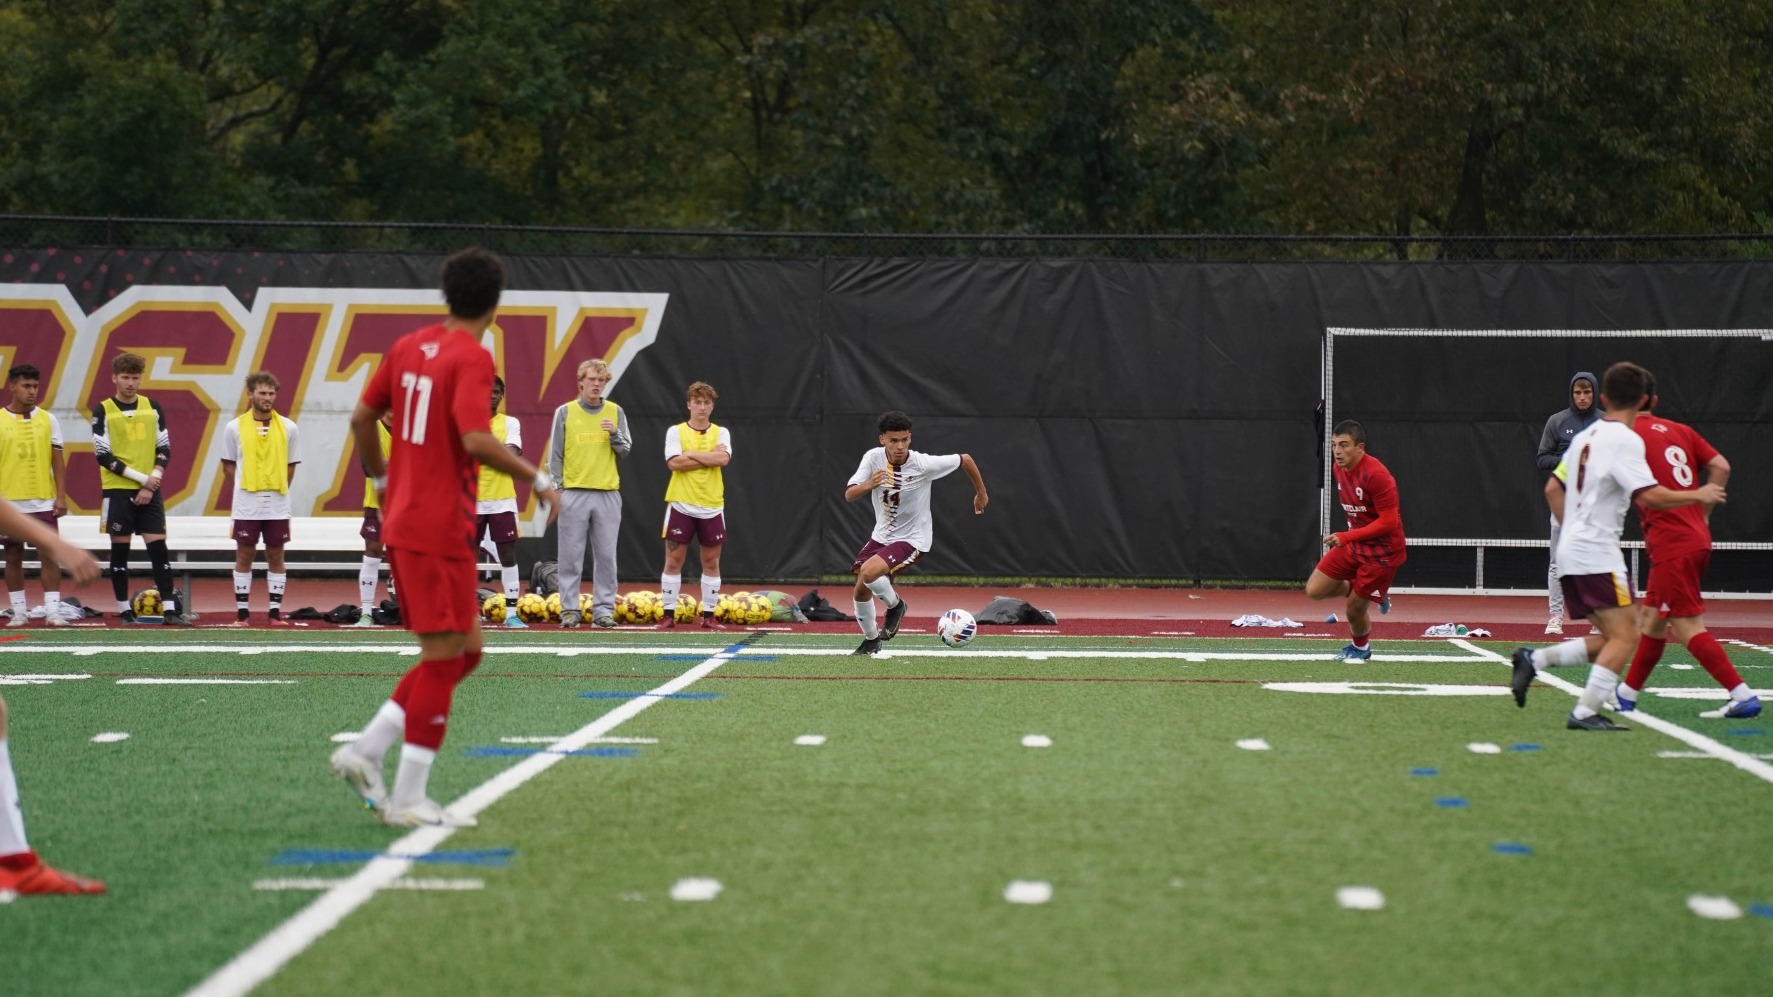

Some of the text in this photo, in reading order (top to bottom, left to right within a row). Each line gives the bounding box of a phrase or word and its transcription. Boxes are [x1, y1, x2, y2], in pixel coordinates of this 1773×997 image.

[401, 371, 433, 446] 11
[1664, 445, 1694, 487] 8
[882, 489, 901, 506] 14
[1355, 487, 1363, 500] 9
